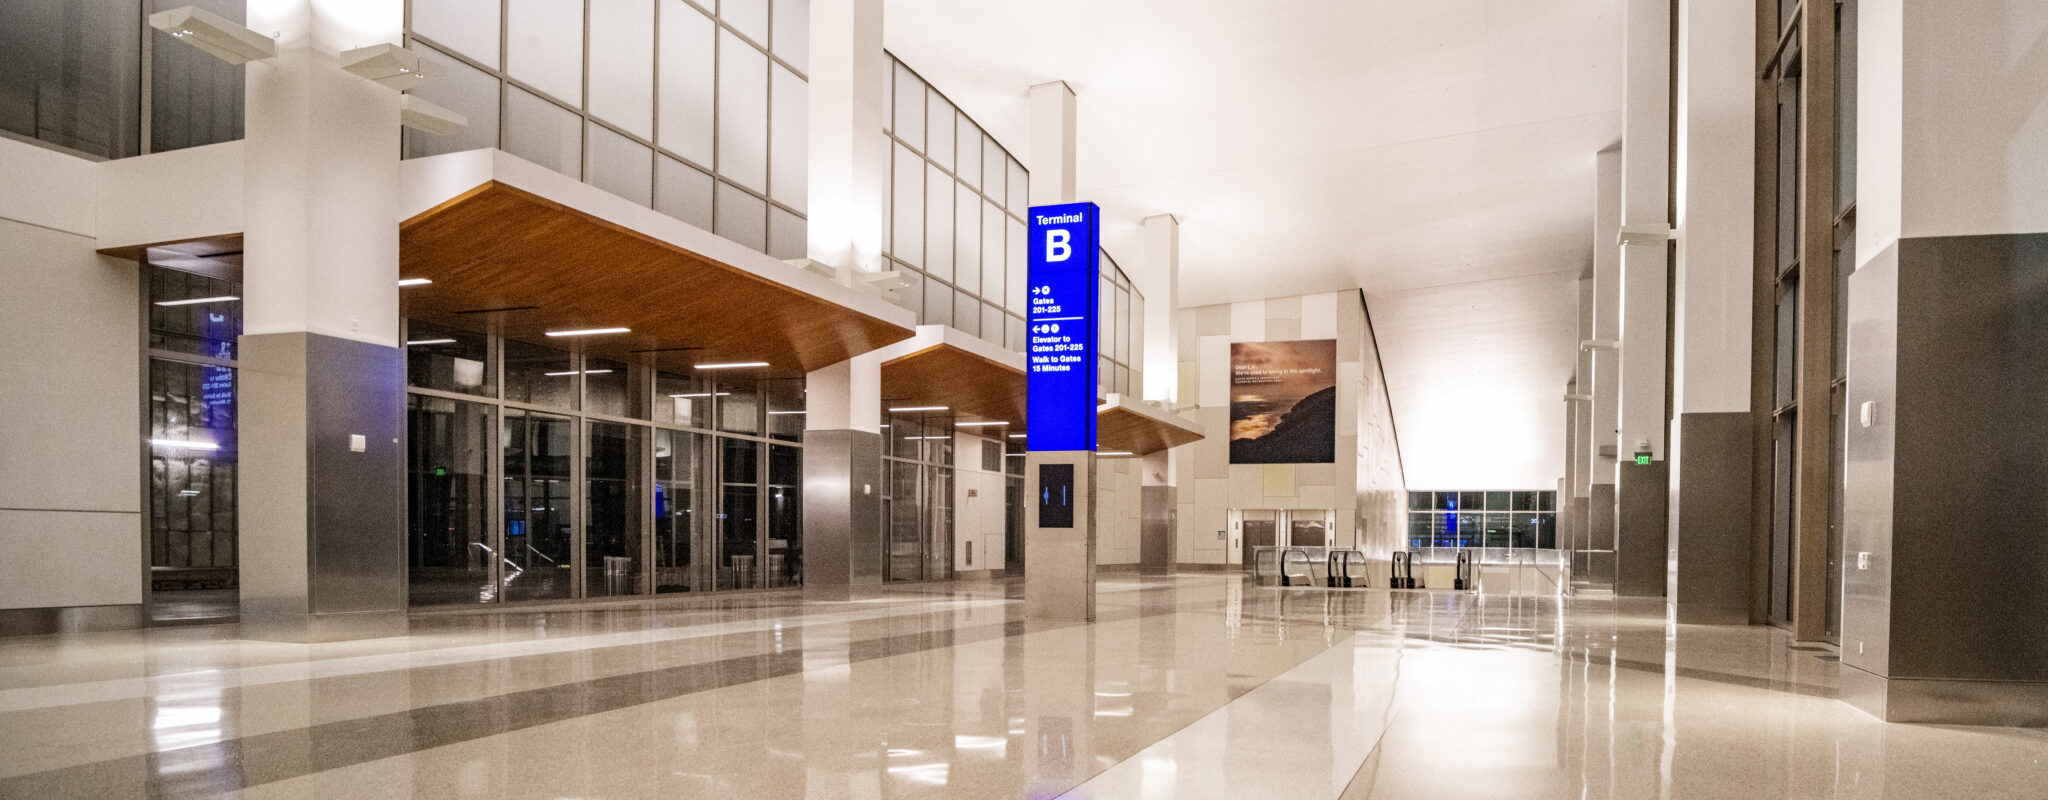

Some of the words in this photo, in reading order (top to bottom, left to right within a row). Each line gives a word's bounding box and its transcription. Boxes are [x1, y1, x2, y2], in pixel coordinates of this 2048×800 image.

[1036, 212, 1083, 225] Terminal
[1046, 229, 1072, 262] B
[1033, 305, 1061, 313] 201-225
[1637, 456, 1649, 465] EXIT
